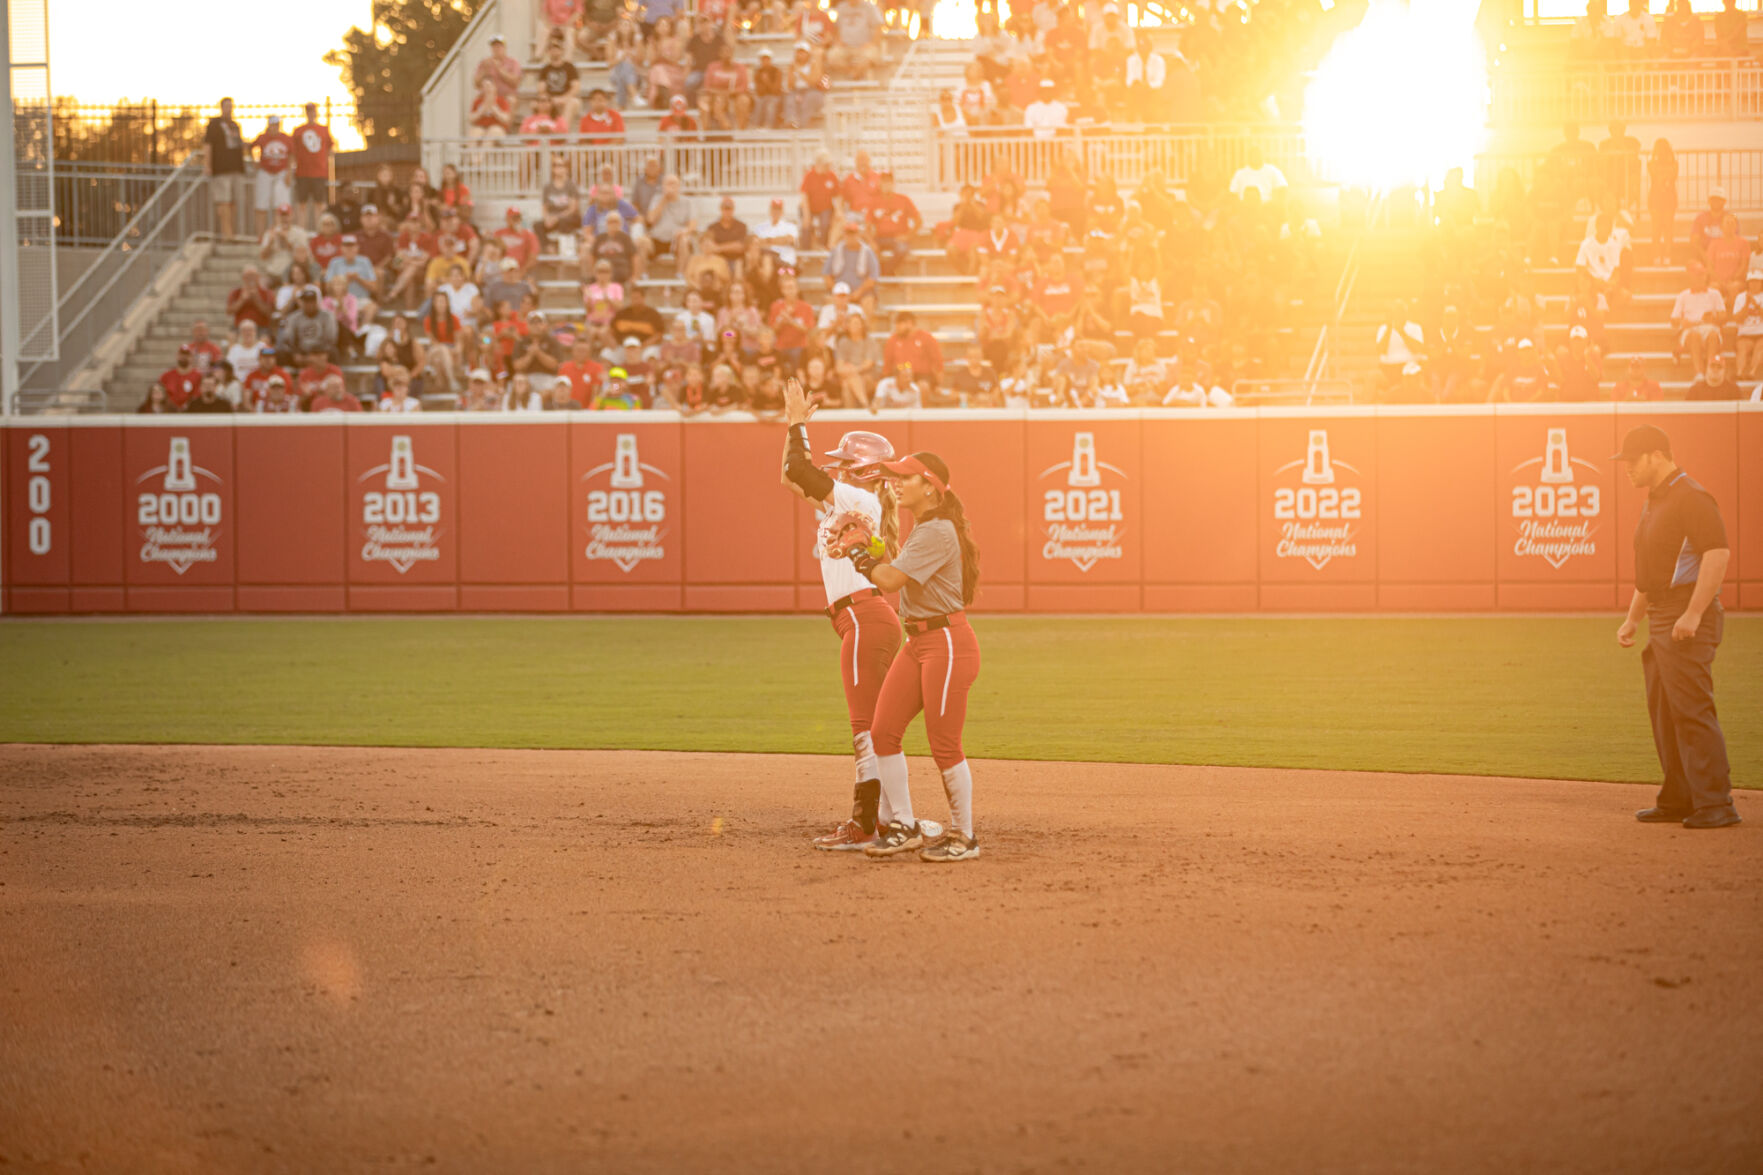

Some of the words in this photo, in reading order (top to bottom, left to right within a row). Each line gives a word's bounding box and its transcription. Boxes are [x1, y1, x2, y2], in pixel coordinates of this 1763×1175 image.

[28, 434, 51, 555] 200
[138, 493, 221, 525] 2000
[363, 491, 441, 524] 2013
[587, 490, 665, 522] 2016
[1044, 489, 1123, 521] 2021
[1274, 487, 1361, 519] 2022
[1512, 486, 1600, 517] 2023
[1048, 523, 1116, 543] National
[1282, 521, 1350, 541] National
[1520, 519, 1589, 539] National
[1276, 539, 1356, 561] Champions
[1514, 537, 1596, 559] Champions
